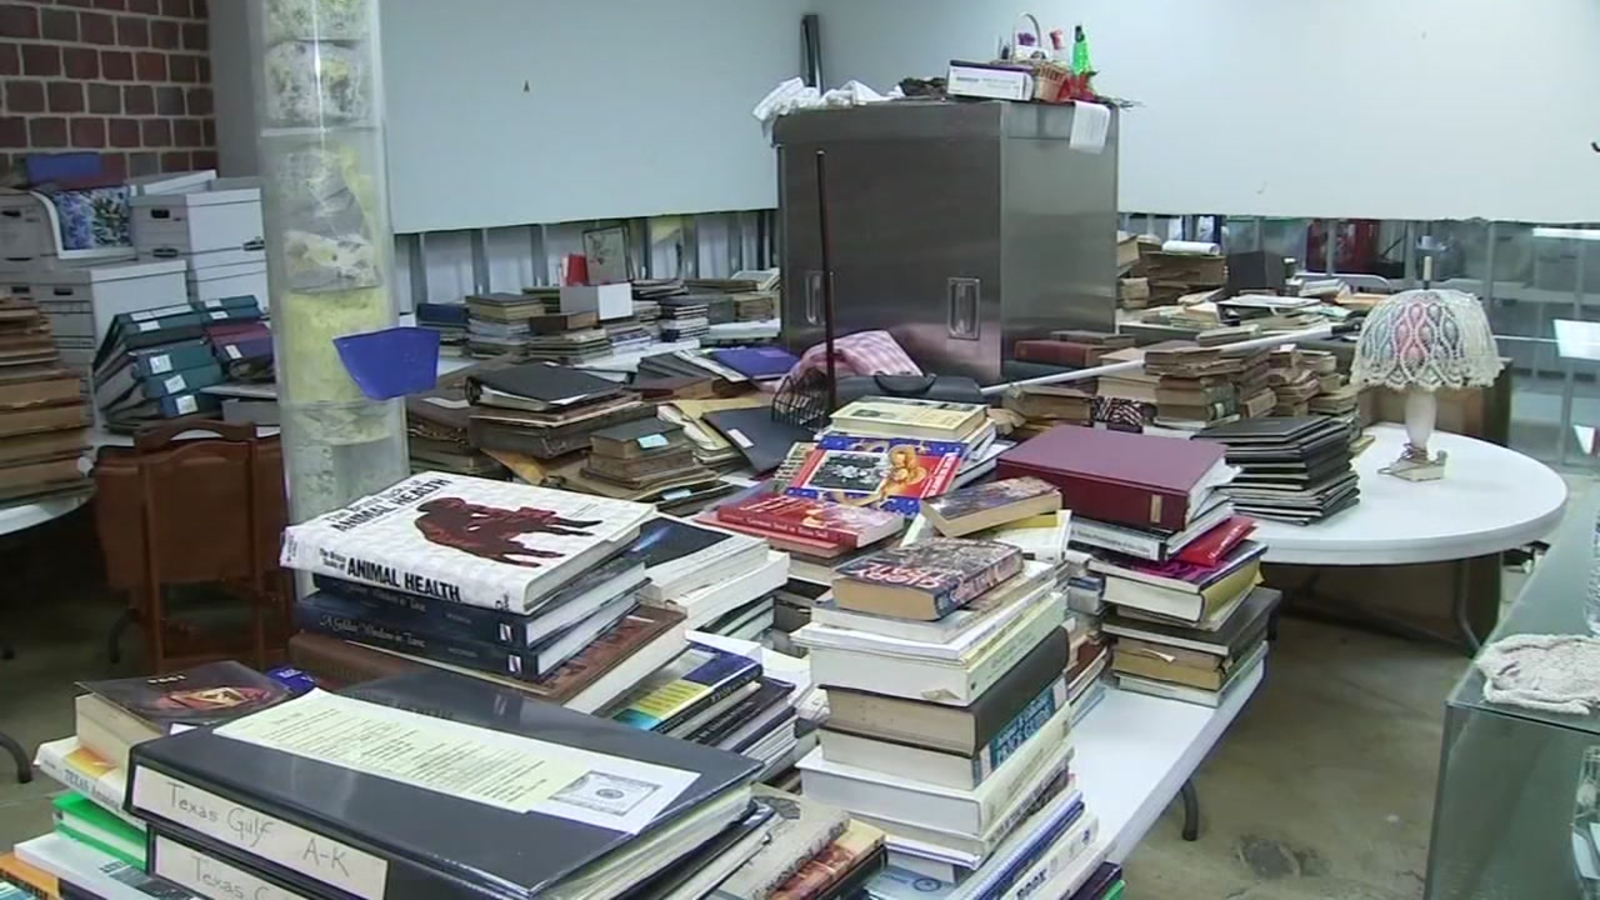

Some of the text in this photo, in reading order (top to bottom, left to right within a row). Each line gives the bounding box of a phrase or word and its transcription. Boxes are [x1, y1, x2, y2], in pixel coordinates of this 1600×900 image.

[331, 504, 398, 532] ANIMAL
[394, 477, 453, 506] HEALTH
[347, 557, 400, 588] ANIMAL
[404, 571, 461, 602] HEALTH
[846, 569, 940, 588] GLORY
[166, 781, 218, 823] Texas
[227, 807, 278, 849] Gulf
[302, 837, 350, 877] A-K
[191, 855, 245, 900] Texas
